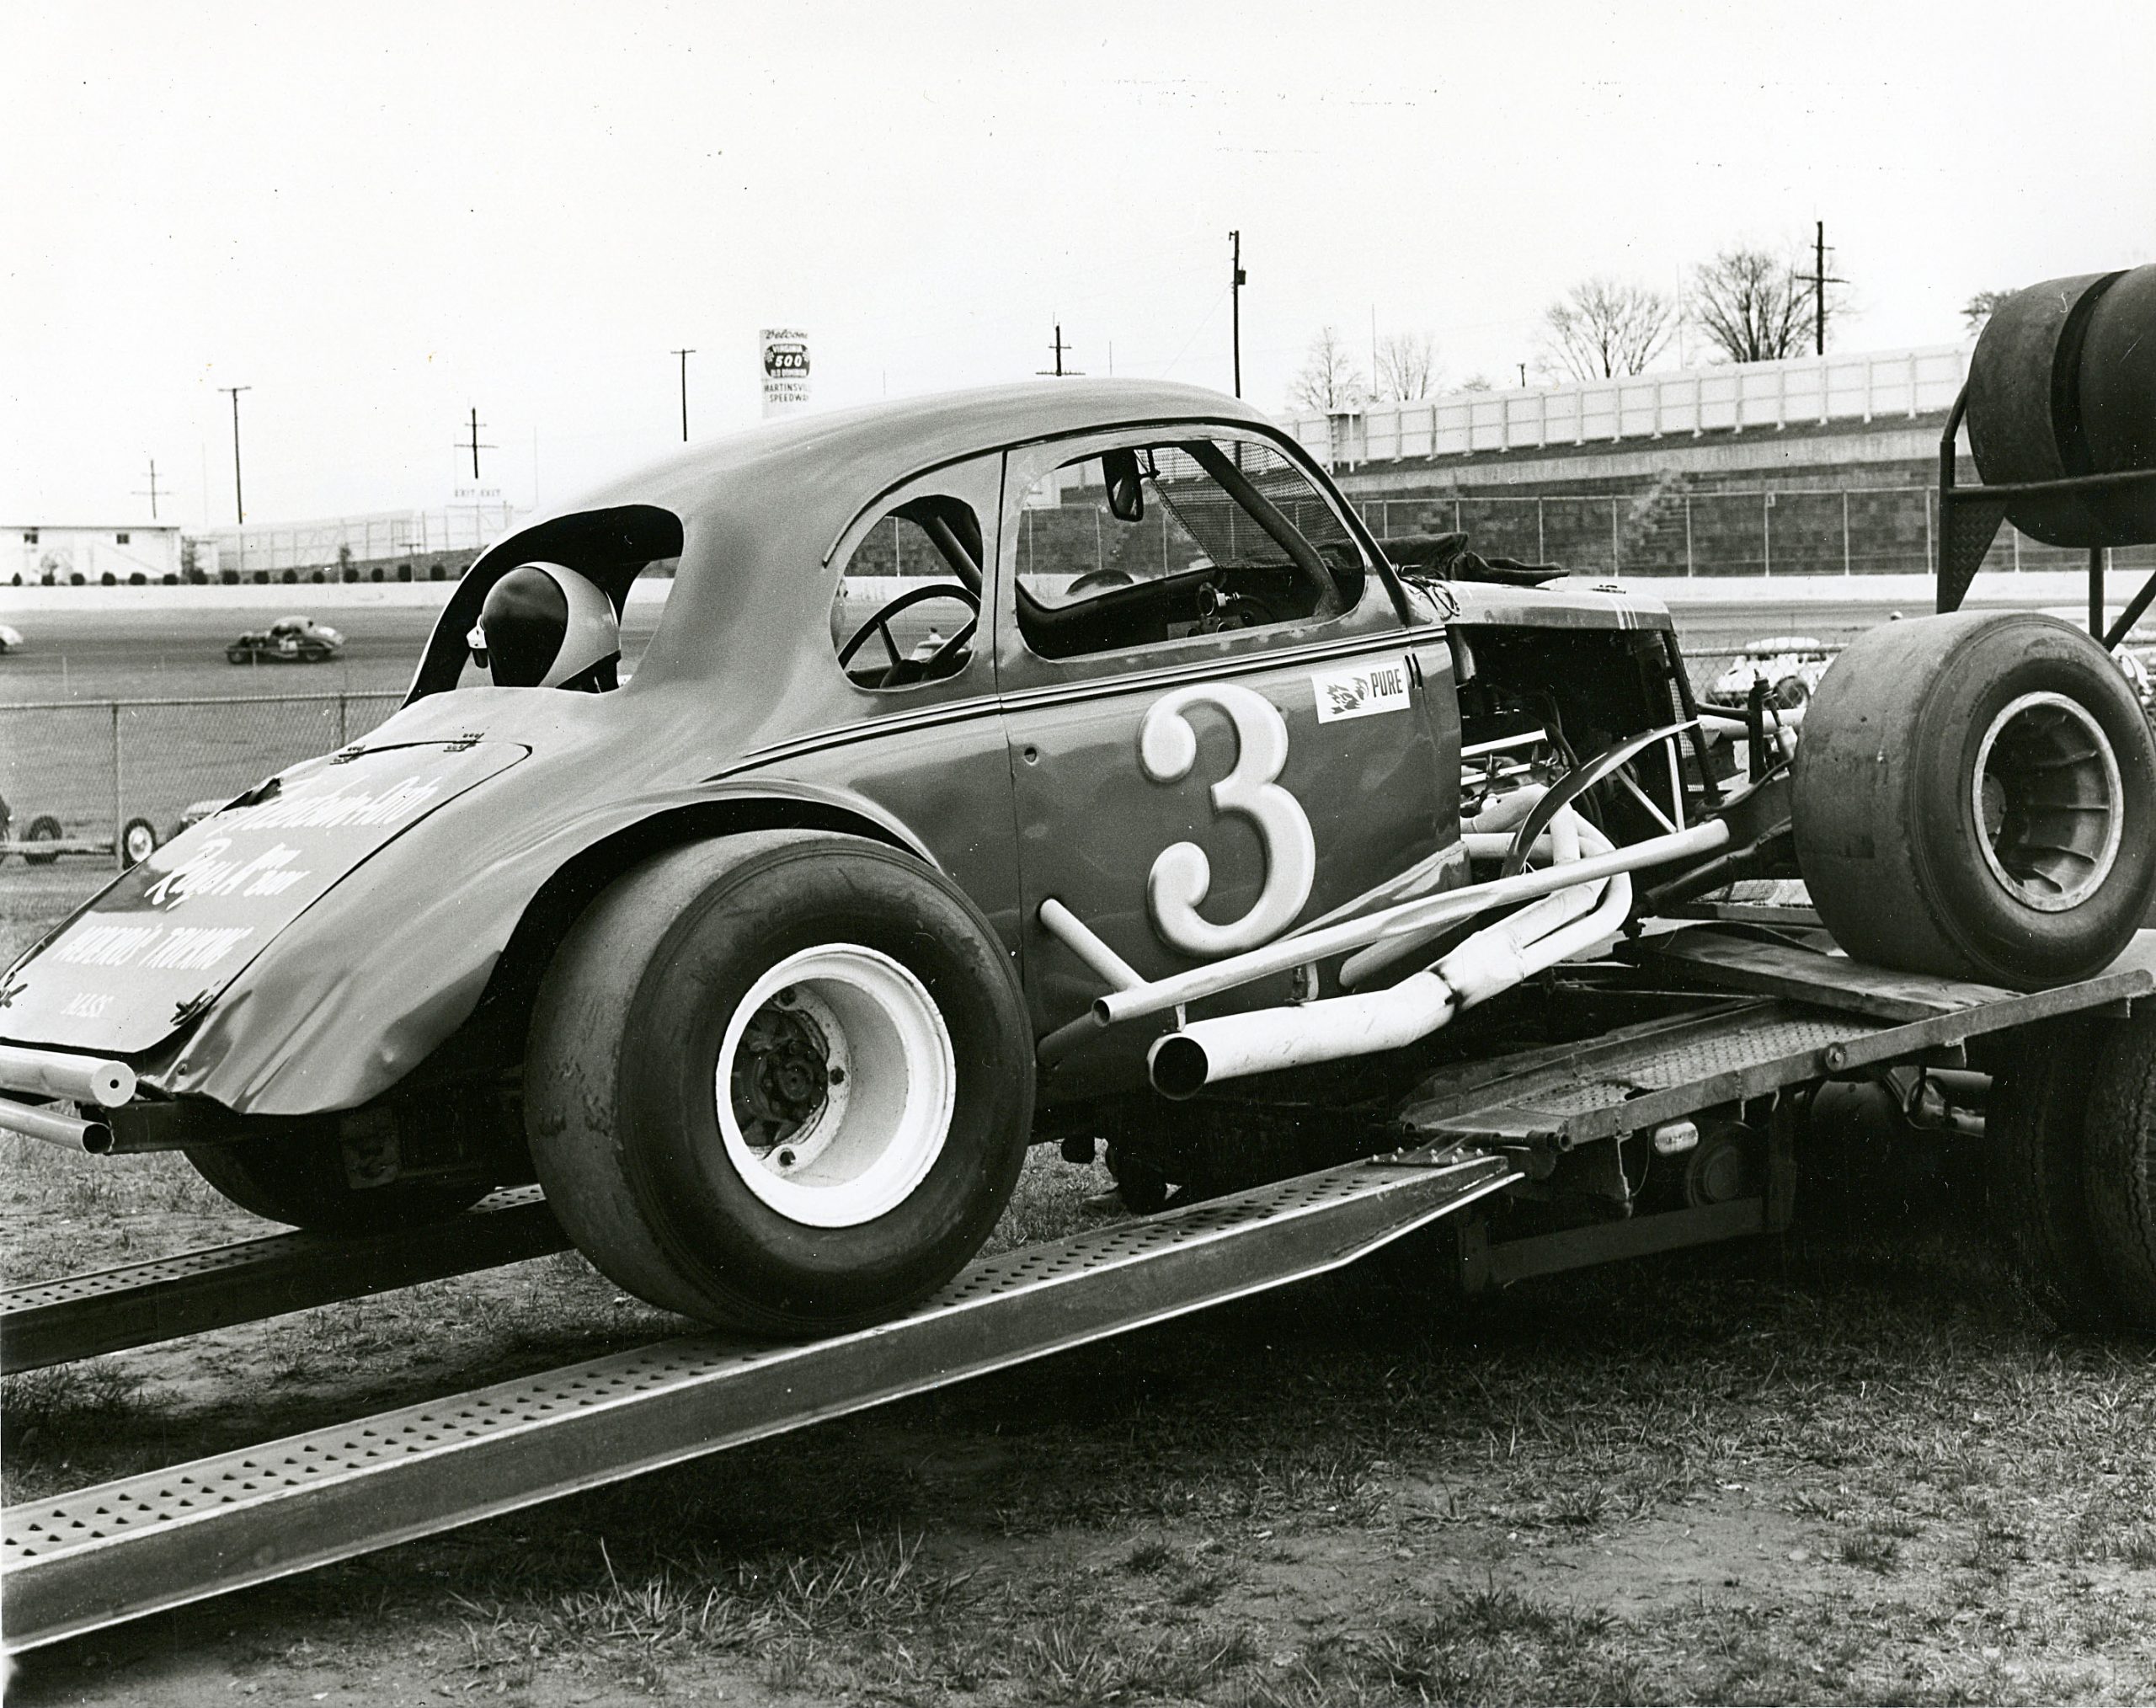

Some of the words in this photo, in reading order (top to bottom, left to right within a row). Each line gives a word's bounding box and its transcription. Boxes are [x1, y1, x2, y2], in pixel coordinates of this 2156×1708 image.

[775, 355, 803, 367] 500
[764, 383, 812, 392] MARTINSV
[1370, 669, 1403, 697] PURE
[1139, 683, 1315, 955] 3
[138, 926, 254, 970] TRUCKING
